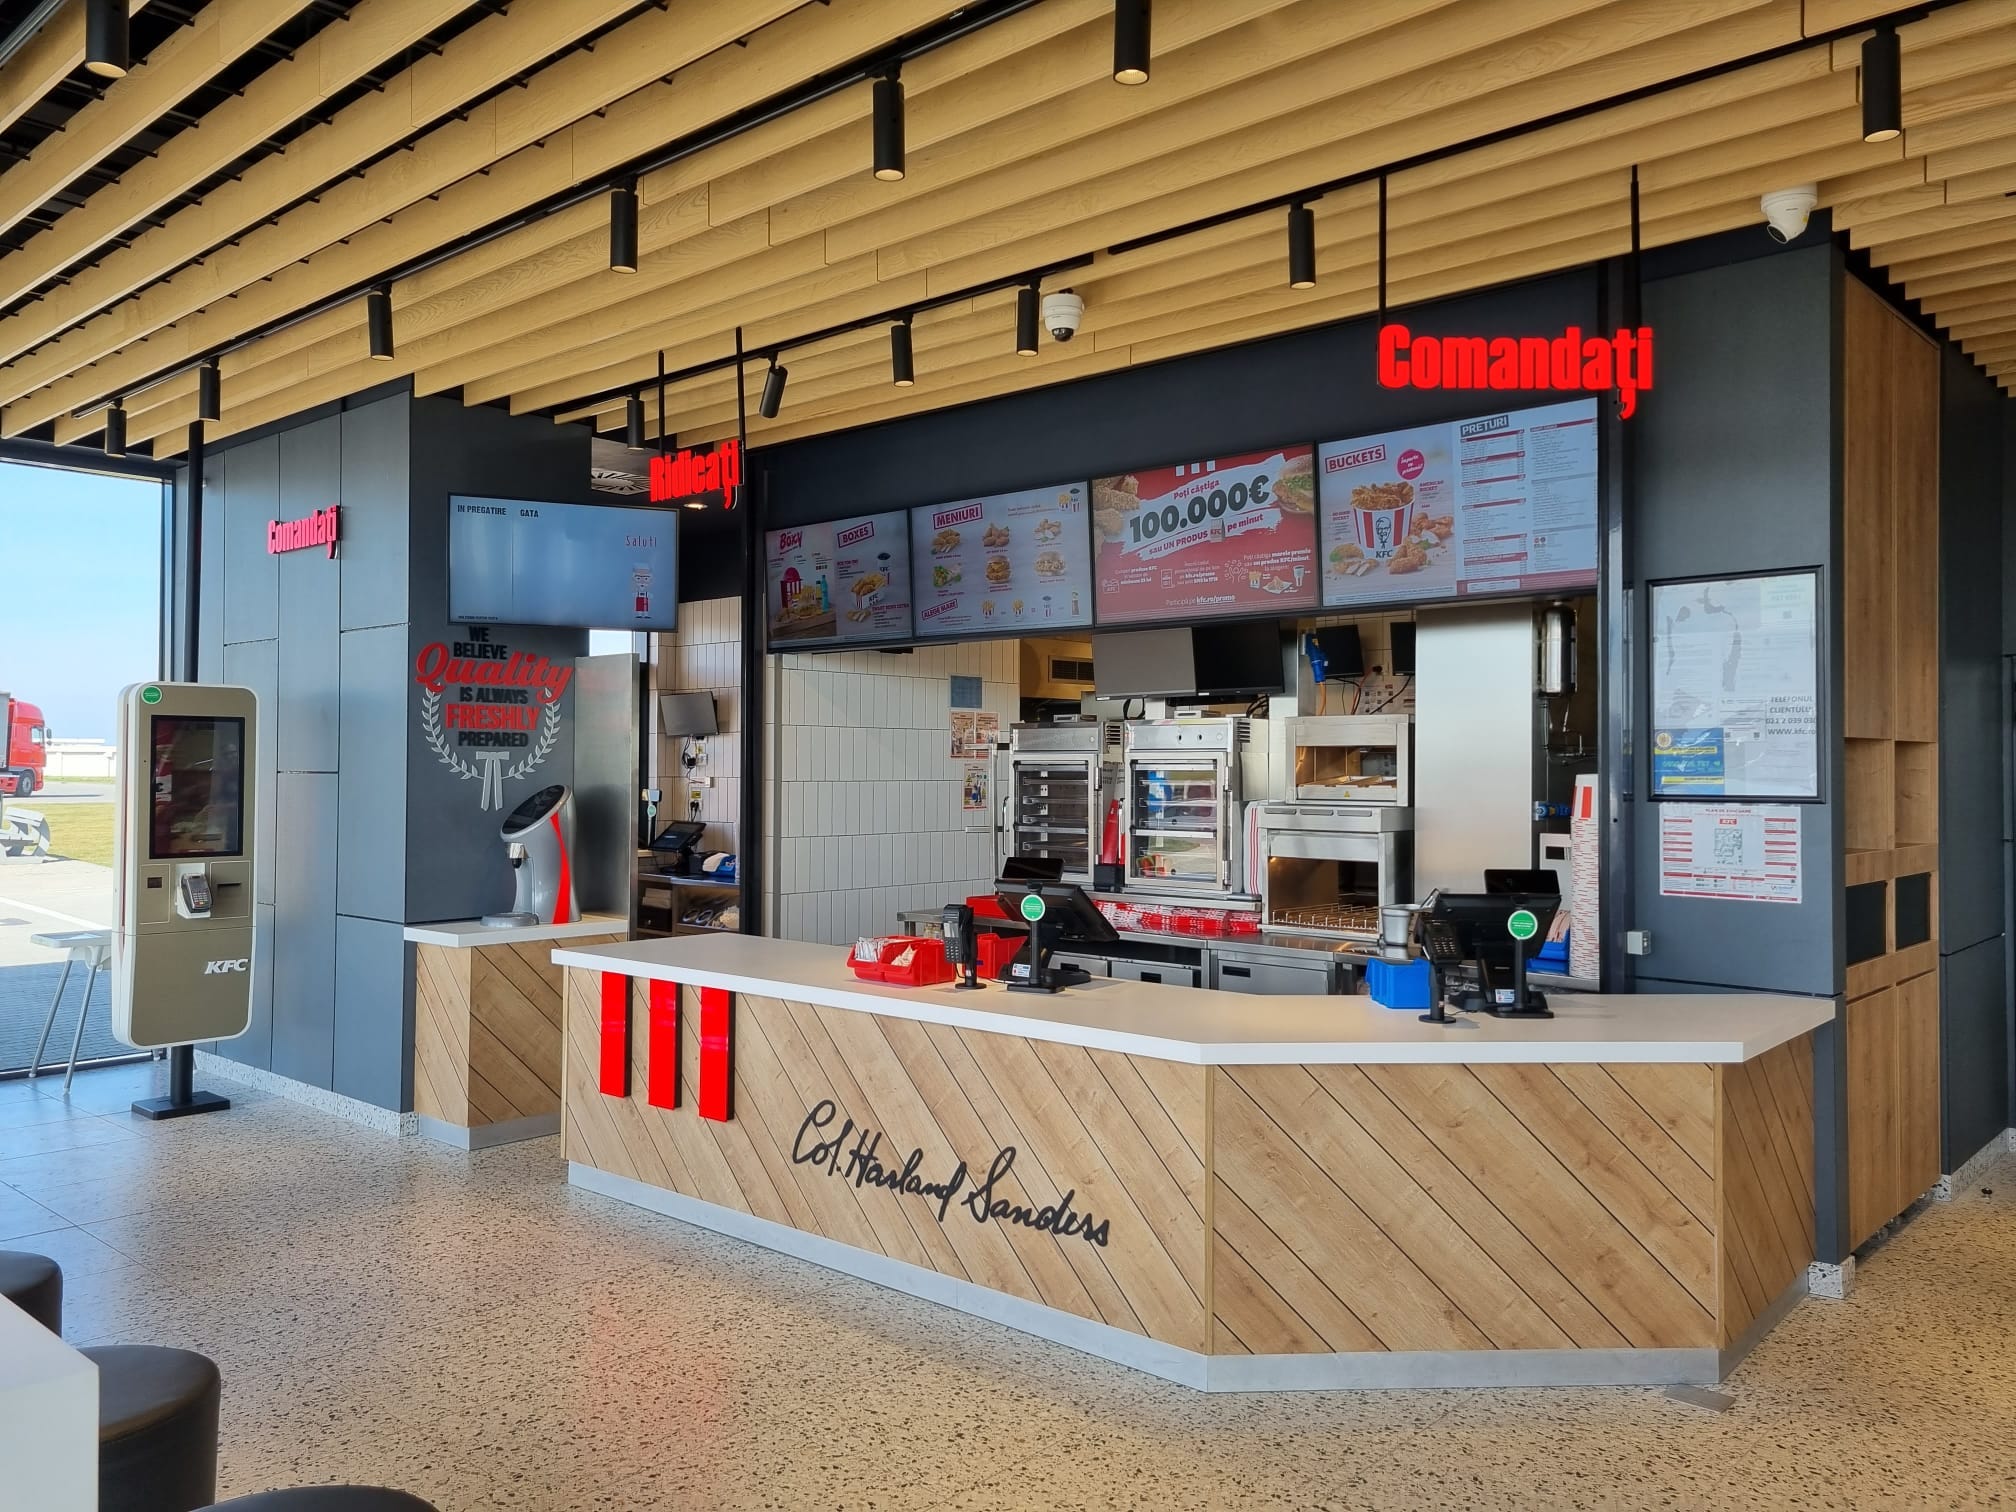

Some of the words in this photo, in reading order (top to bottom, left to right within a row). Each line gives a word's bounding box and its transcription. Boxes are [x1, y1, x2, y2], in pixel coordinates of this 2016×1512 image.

[1377, 323, 1653, 421] Comandați
[1461, 416, 1508, 436] PRETURI
[1328, 448, 1382, 470] BUCKETS
[650, 439, 741, 511] Ridicați
[457, 504, 466, 513] IN
[467, 505, 507, 515] PREGATIRE
[519, 508, 539, 518] GATA
[936, 506, 979, 527] MENIURI
[1130, 475, 1270, 543] 100.000€
[842, 526, 869, 543] BOXES
[1149, 545, 1163, 555] sau
[1163, 542, 1175, 552] UN
[1176, 531, 1208, 546] PRODUS
[1228, 522, 1238, 533] pe
[1239, 513, 1264, 528] minut
[1375, 549, 1393, 559] KFC
[468, 626, 490, 642] WE
[453, 642, 508, 660] BELIEVE
[415, 642, 574, 704] Quality
[460, 686, 473, 702] IS
[475, 687, 529, 703] ALWAYS
[1770, 695, 1814, 703] TELEFONUL
[444, 704, 541, 731] FRESHLY
[458, 731, 529, 747] PREPARED
[204, 958, 249, 975] KFC
[792, 1099, 854, 1176] Col.
[845, 1129, 967, 1222] Harland
[961, 1146, 1111, 1247] Sanders
